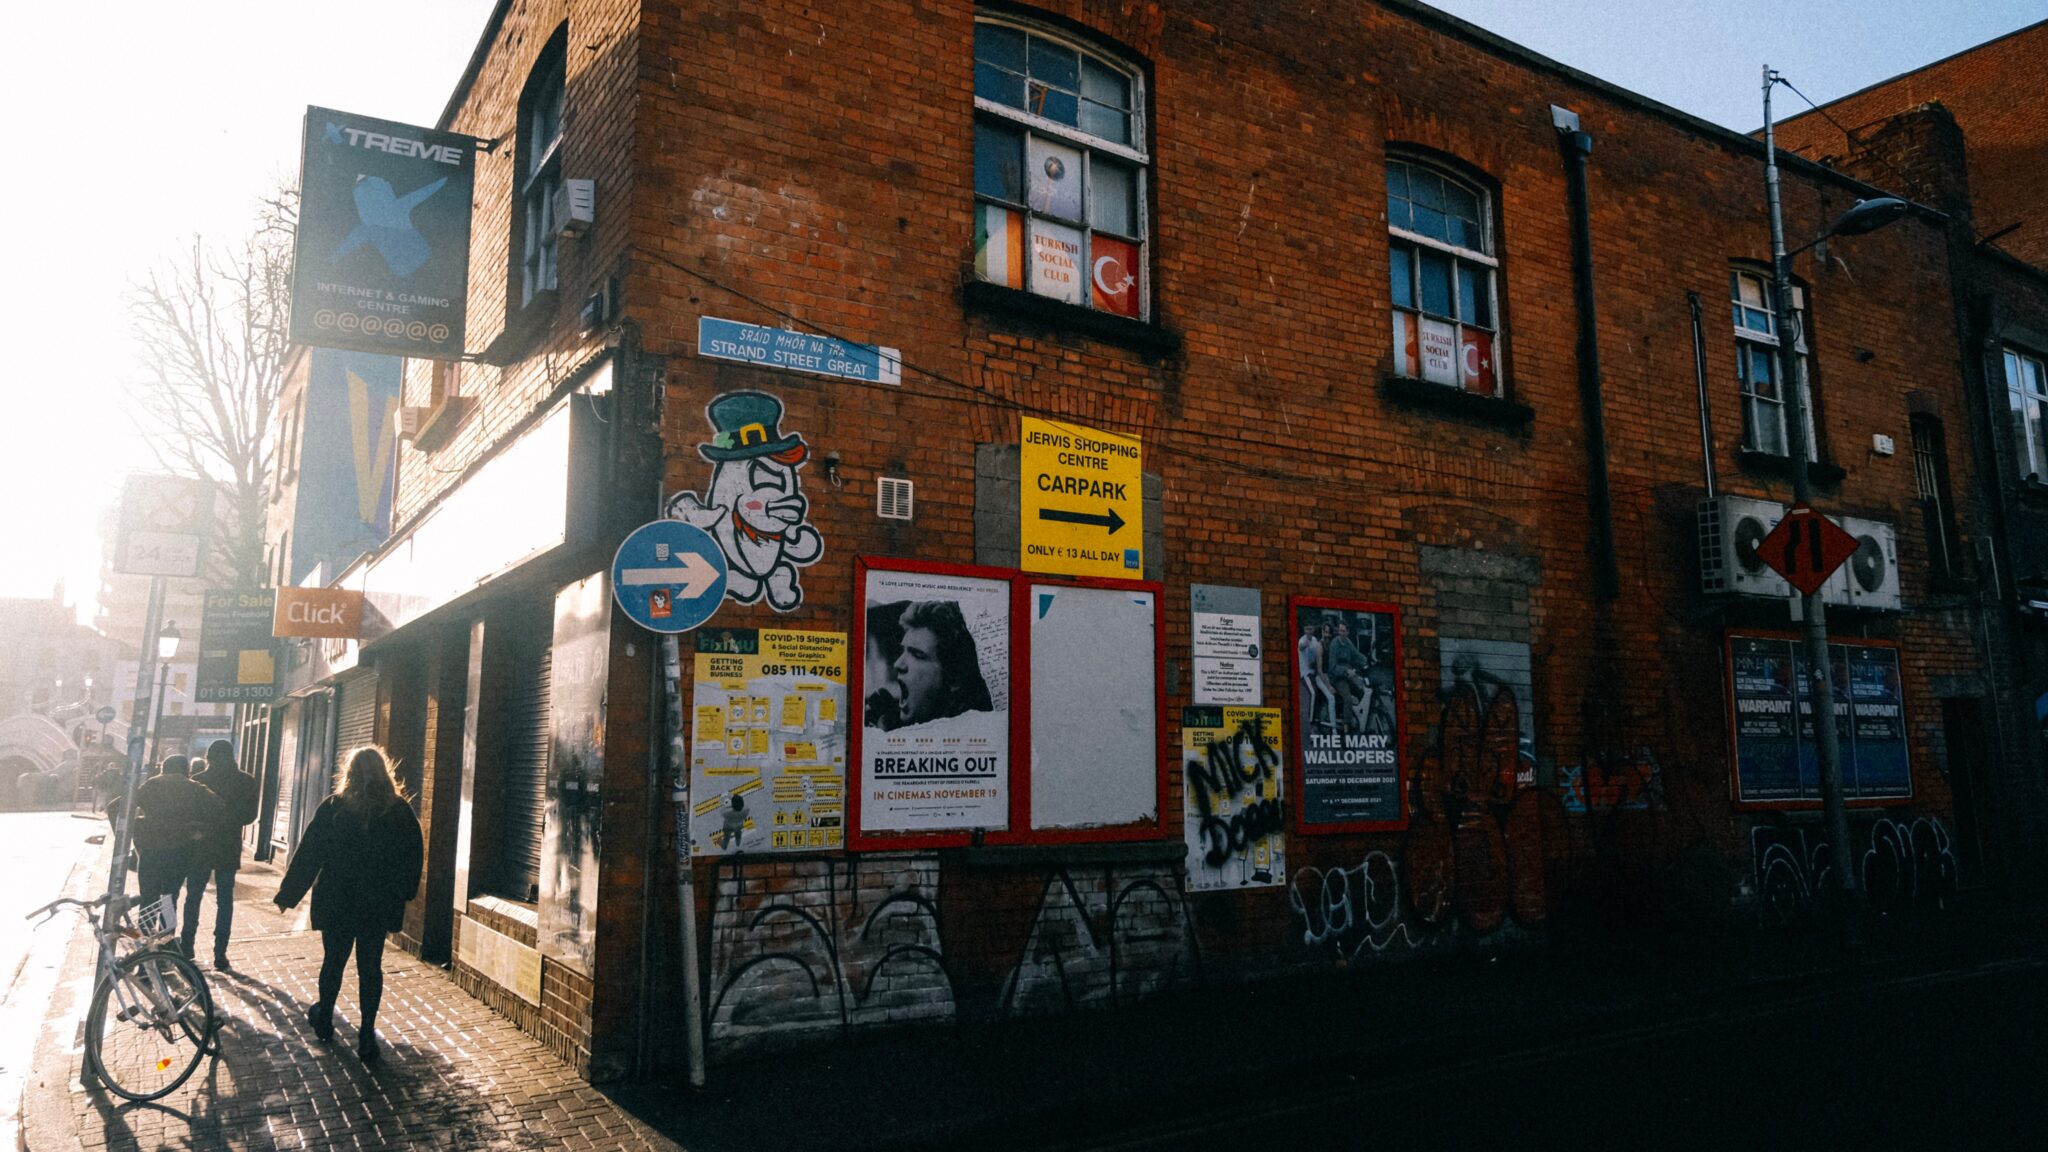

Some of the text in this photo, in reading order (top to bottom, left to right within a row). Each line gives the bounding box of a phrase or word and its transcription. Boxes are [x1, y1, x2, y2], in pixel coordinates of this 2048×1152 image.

[322, 121, 463, 165] XTREME
[1034, 234, 1078, 255] TURKISH
[1039, 251, 1073, 270] SOCIAL
[1044, 268, 1070, 283] CLUB
[317, 282, 449, 308] INTERNET & GAMING
[358, 300, 410, 314] CENTRE
[810, 341, 824, 354] NA
[1425, 344, 1449, 358] SOCIAL
[711, 339, 766, 360] STRAND
[774, 350, 822, 369] STREET
[828, 359, 868, 376] GREAT
[1026, 431, 1138, 459] JERVIS SHOPPING
[1058, 452, 1109, 471] CENTRE
[1037, 473, 1127, 501] CARPARK
[1027, 544, 1055, 556] ONLY
[1066, 548, 1077, 558] 13
[1080, 549, 1098, 561] ALL
[1101, 551, 1120, 562] DAY
[208, 593, 273, 608] For Sale
[288, 601, 344, 624] Click
[764, 633, 840, 645] COVID-19 Signage
[762, 664, 841, 677] 085 111 4766
[200, 686, 273, 698] 01 618 1300
[1737, 699, 1792, 713] WARPAINT
[1854, 703, 1899, 717] WARPAINT
[1310, 734, 1388, 748] THE MARY
[1304, 750, 1395, 764] WALLOPERS
[874, 756, 997, 774] BREAKING OUT
[874, 789, 997, 800] IN CINEMAS NOVEMBER 19
